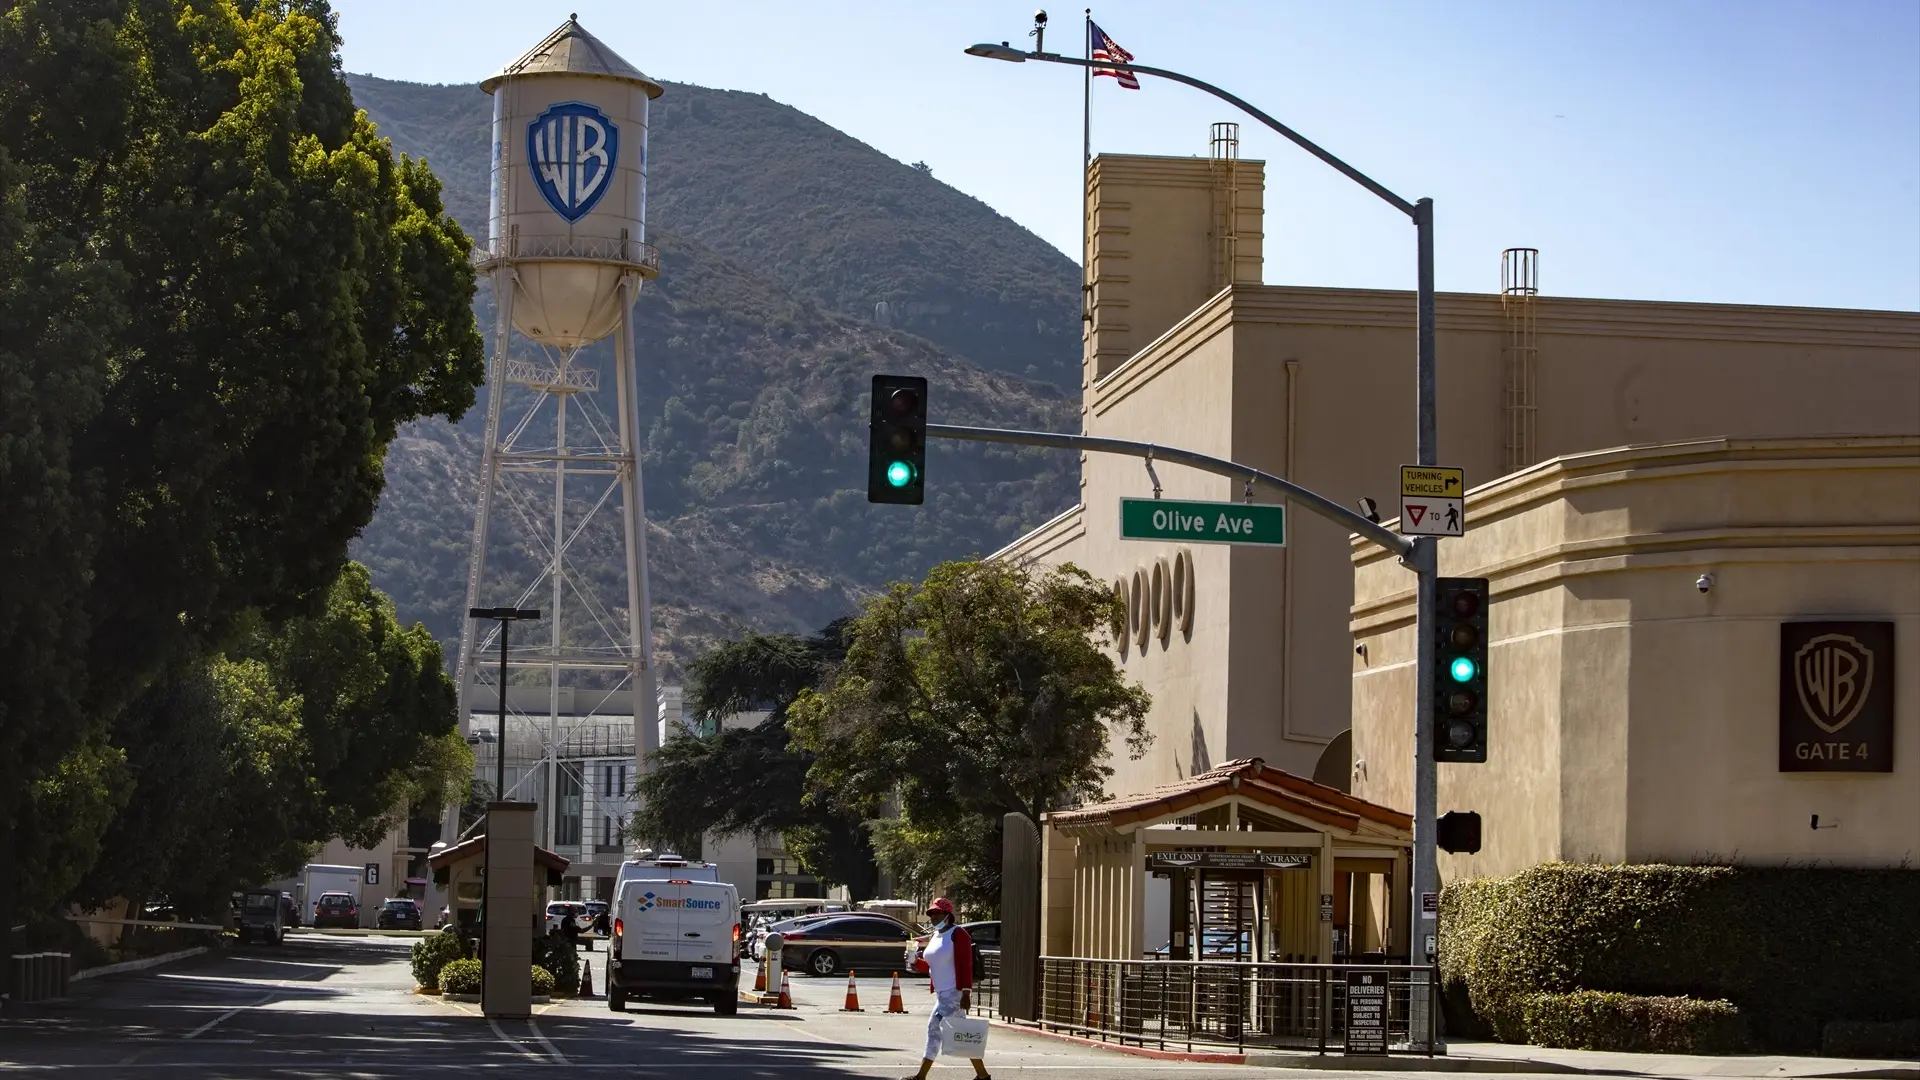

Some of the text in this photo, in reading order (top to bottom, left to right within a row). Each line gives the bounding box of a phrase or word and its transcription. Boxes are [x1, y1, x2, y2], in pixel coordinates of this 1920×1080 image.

[1406, 471, 1443, 480] TURNING
[1405, 484, 1443, 493] VEHICLES
[1430, 512, 1440, 521] TO
[1152, 509, 1254, 534] Olive Ave
[1795, 742, 1869, 760] GATE 4
[1156, 852, 1178, 860] EXIT
[1179, 853, 1203, 861] ONLY
[1260, 855, 1309, 864] ENTRANCE
[368, 867, 377, 884] G
[656, 896, 721, 910] SmartSource
[1362, 975, 1373, 984] NO
[1349, 985, 1385, 995] DELIVERIES
